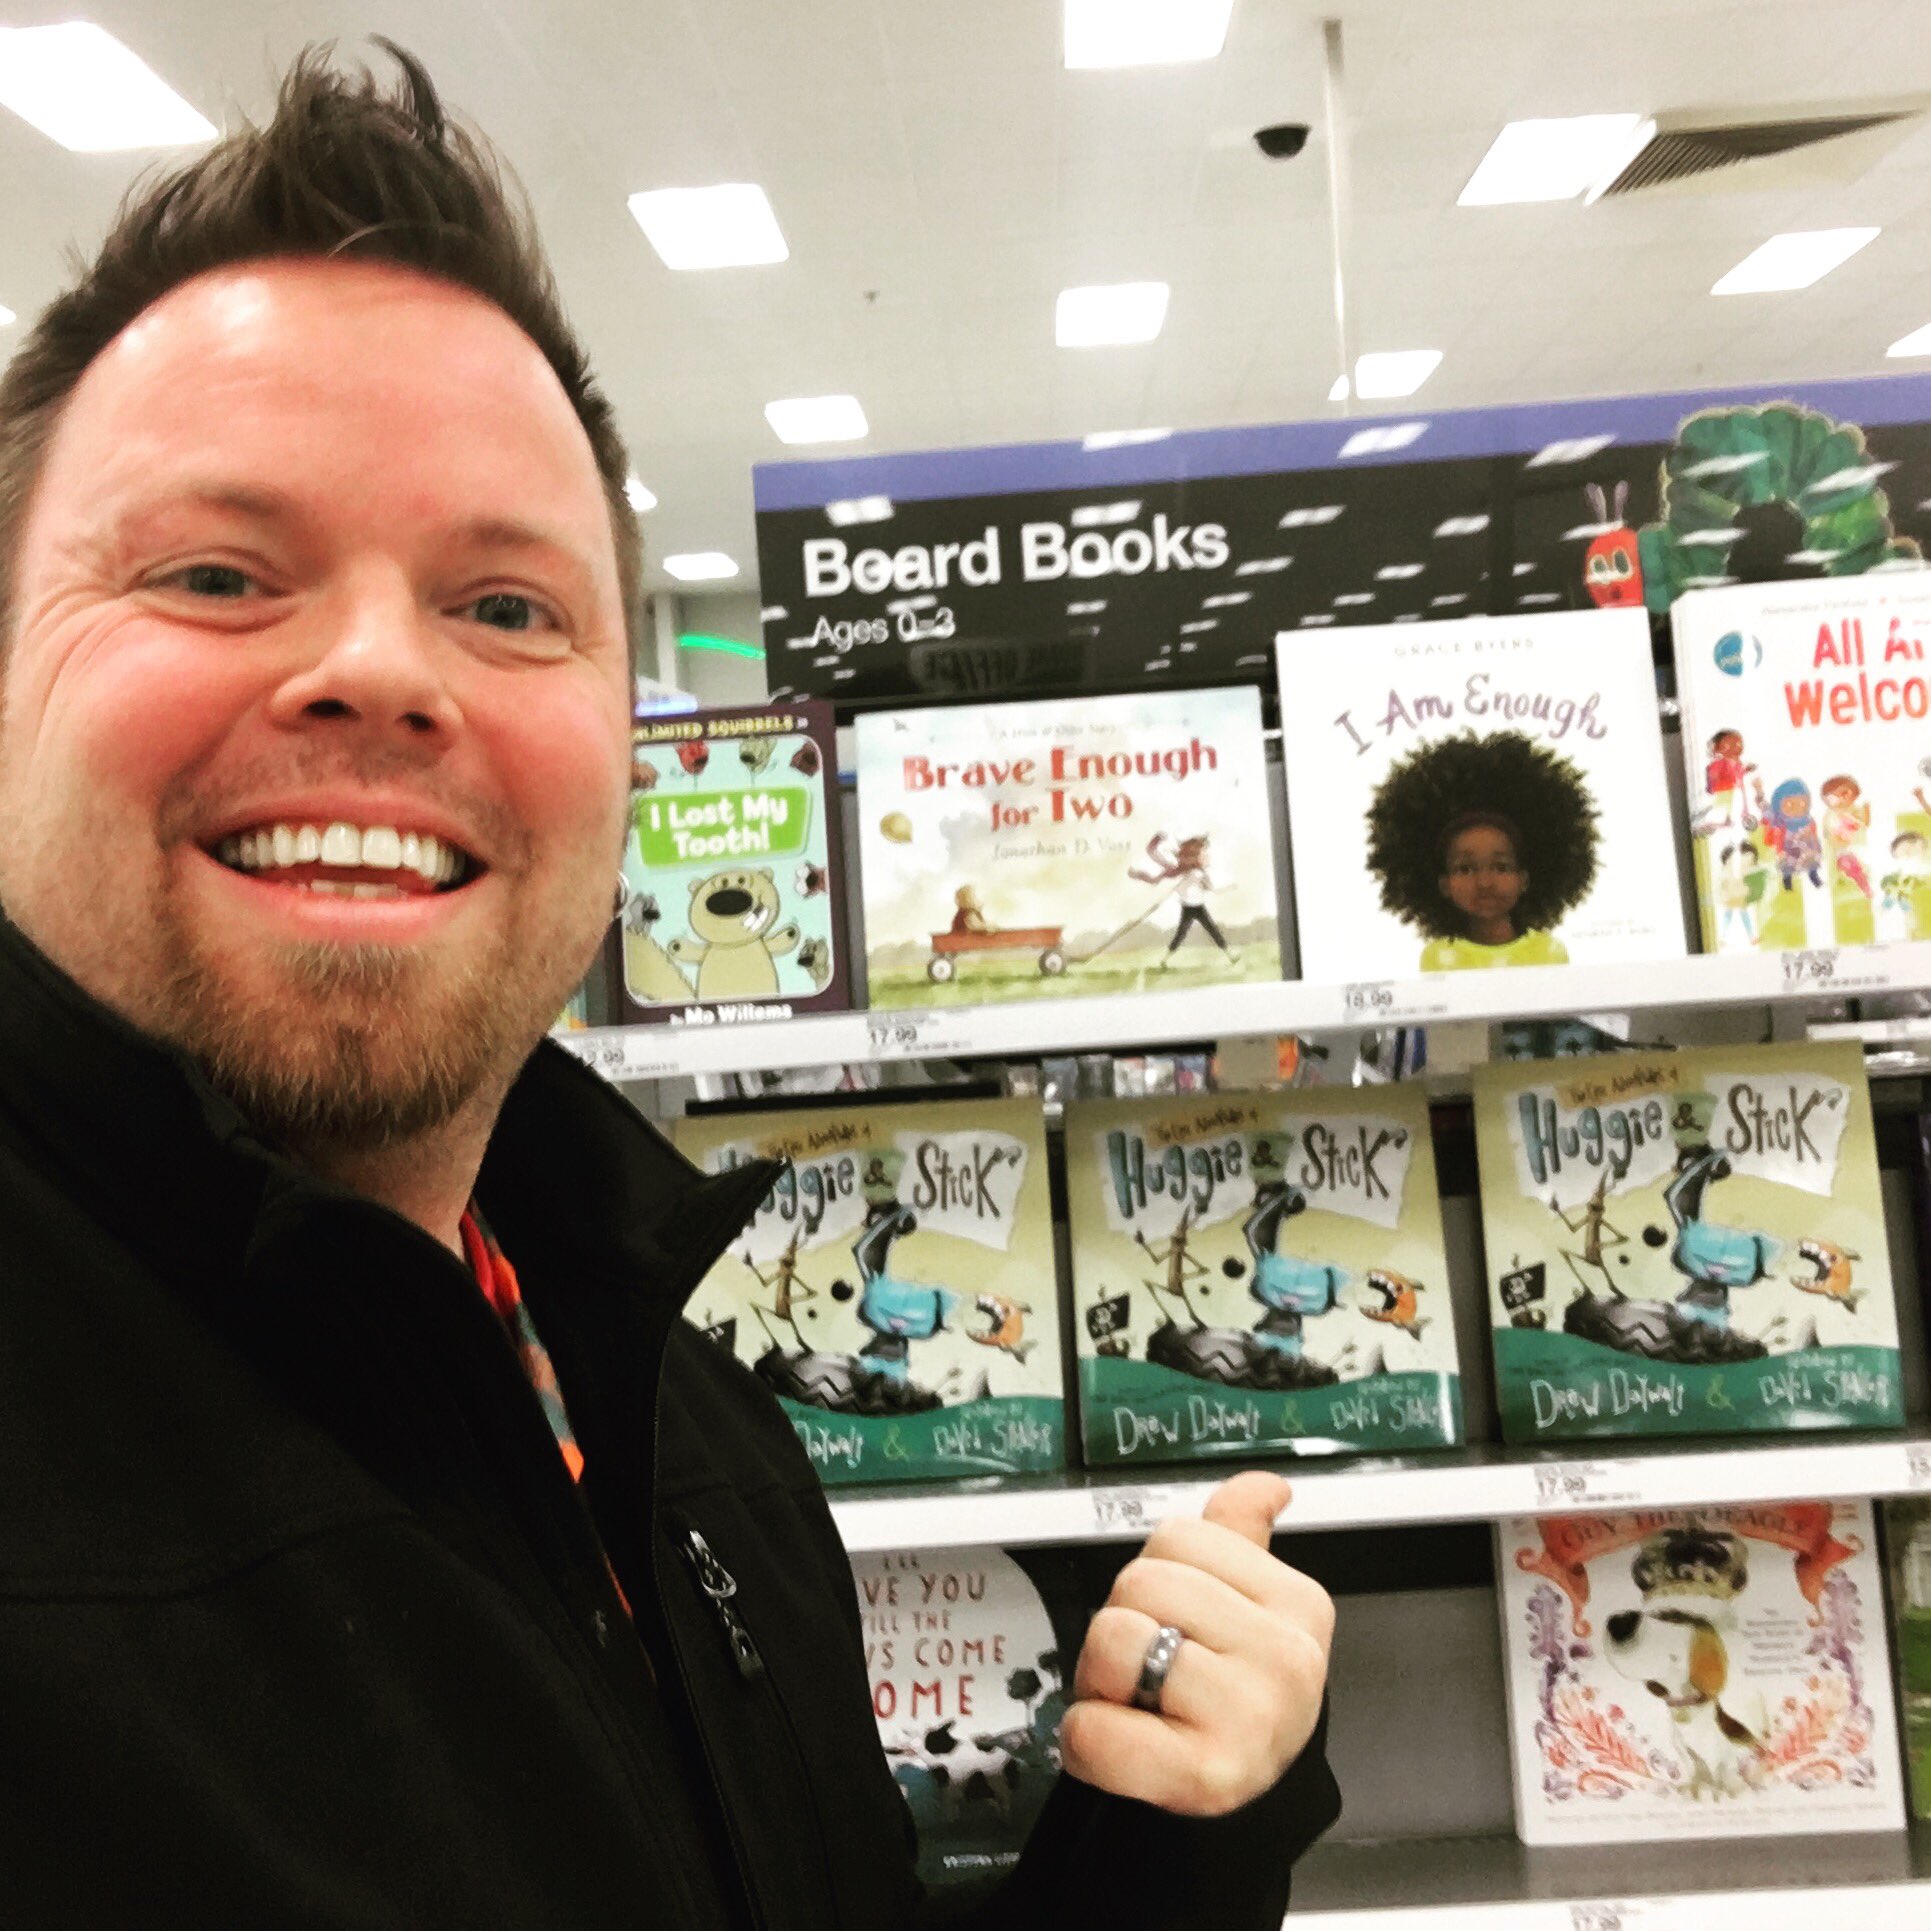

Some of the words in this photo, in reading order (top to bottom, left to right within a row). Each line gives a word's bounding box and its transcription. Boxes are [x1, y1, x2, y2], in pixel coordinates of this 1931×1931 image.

[803, 526, 1002, 597] Board
[1020, 513, 1232, 582] Books
[813, 615, 889, 652] Ages
[1812, 616, 1866, 669] All
[1333, 710, 1373, 756] I
[1376, 688, 1454, 736] Am
[1463, 673, 1609, 741] Enough
[1783, 671, 1931, 730] Welco
[903, 754, 1037, 792] Brave
[1050, 736, 1219, 783] Enough
[650, 802, 661, 832] I
[668, 797, 736, 829] Lost
[741, 791, 790, 826] My
[1045, 786, 1134, 823] Two
[672, 819, 771, 859] Tooth!
[1518, 1092, 1663, 1185] Huggie
[1107, 1129, 1243, 1219] Huggie
[919, 1573, 986, 1604] YOU
[914, 1634, 1007, 1668] COME
